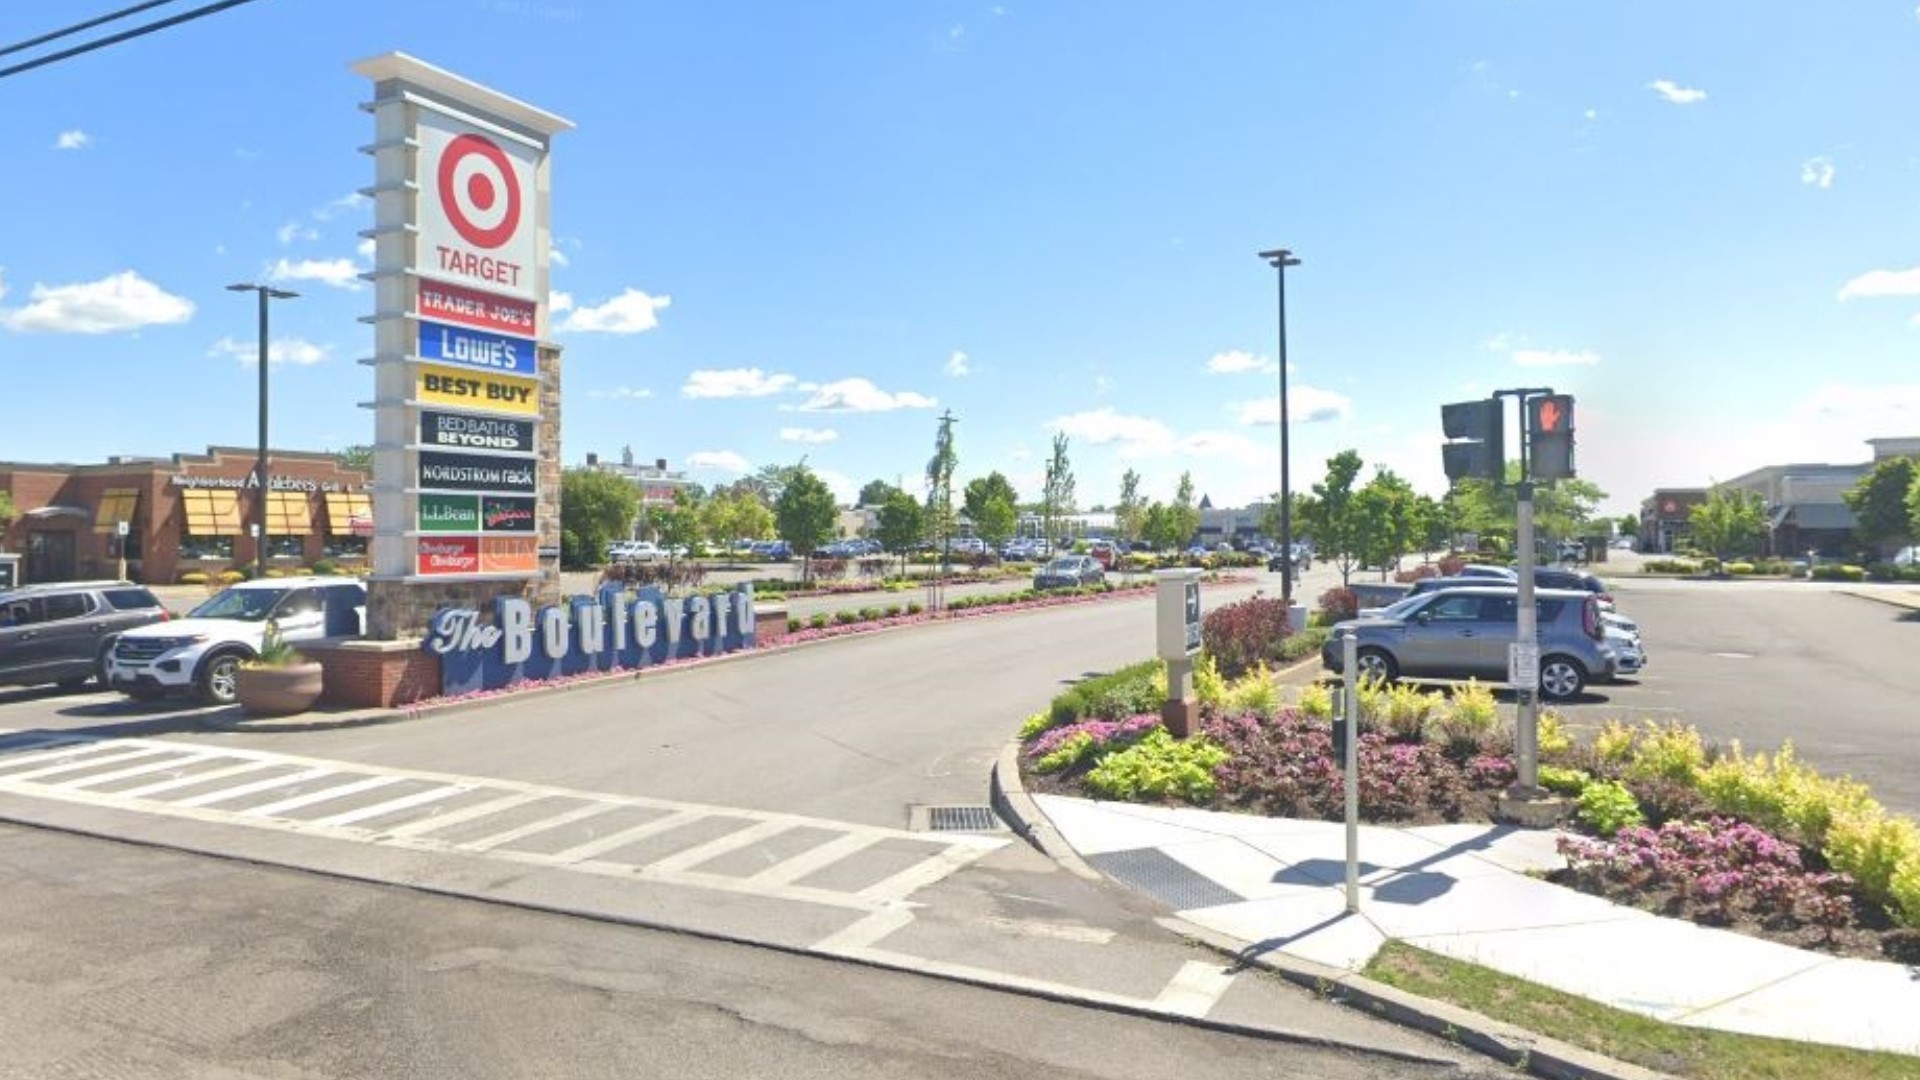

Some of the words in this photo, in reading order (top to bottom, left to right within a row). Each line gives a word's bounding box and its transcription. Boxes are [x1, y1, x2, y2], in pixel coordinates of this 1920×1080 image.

[436, 246, 521, 286] TARGET
[423, 291, 485, 318] TRADER
[490, 306, 532, 327] JOE'S
[441, 329, 517, 369] LOWE'S
[424, 373, 481, 397] BEST
[486, 382, 531, 404] BUY
[438, 416, 466, 431] BED
[468, 419, 505, 435] BATH
[507, 424, 518, 437] &
[438, 432, 519, 448] BEYOND
[423, 465, 500, 483] NORDSTROM
[502, 466, 533, 486] rack
[422, 504, 475, 521] L.L.Bean
[430, 608, 502, 652] The
[503, 582, 756, 665] Boulevard
